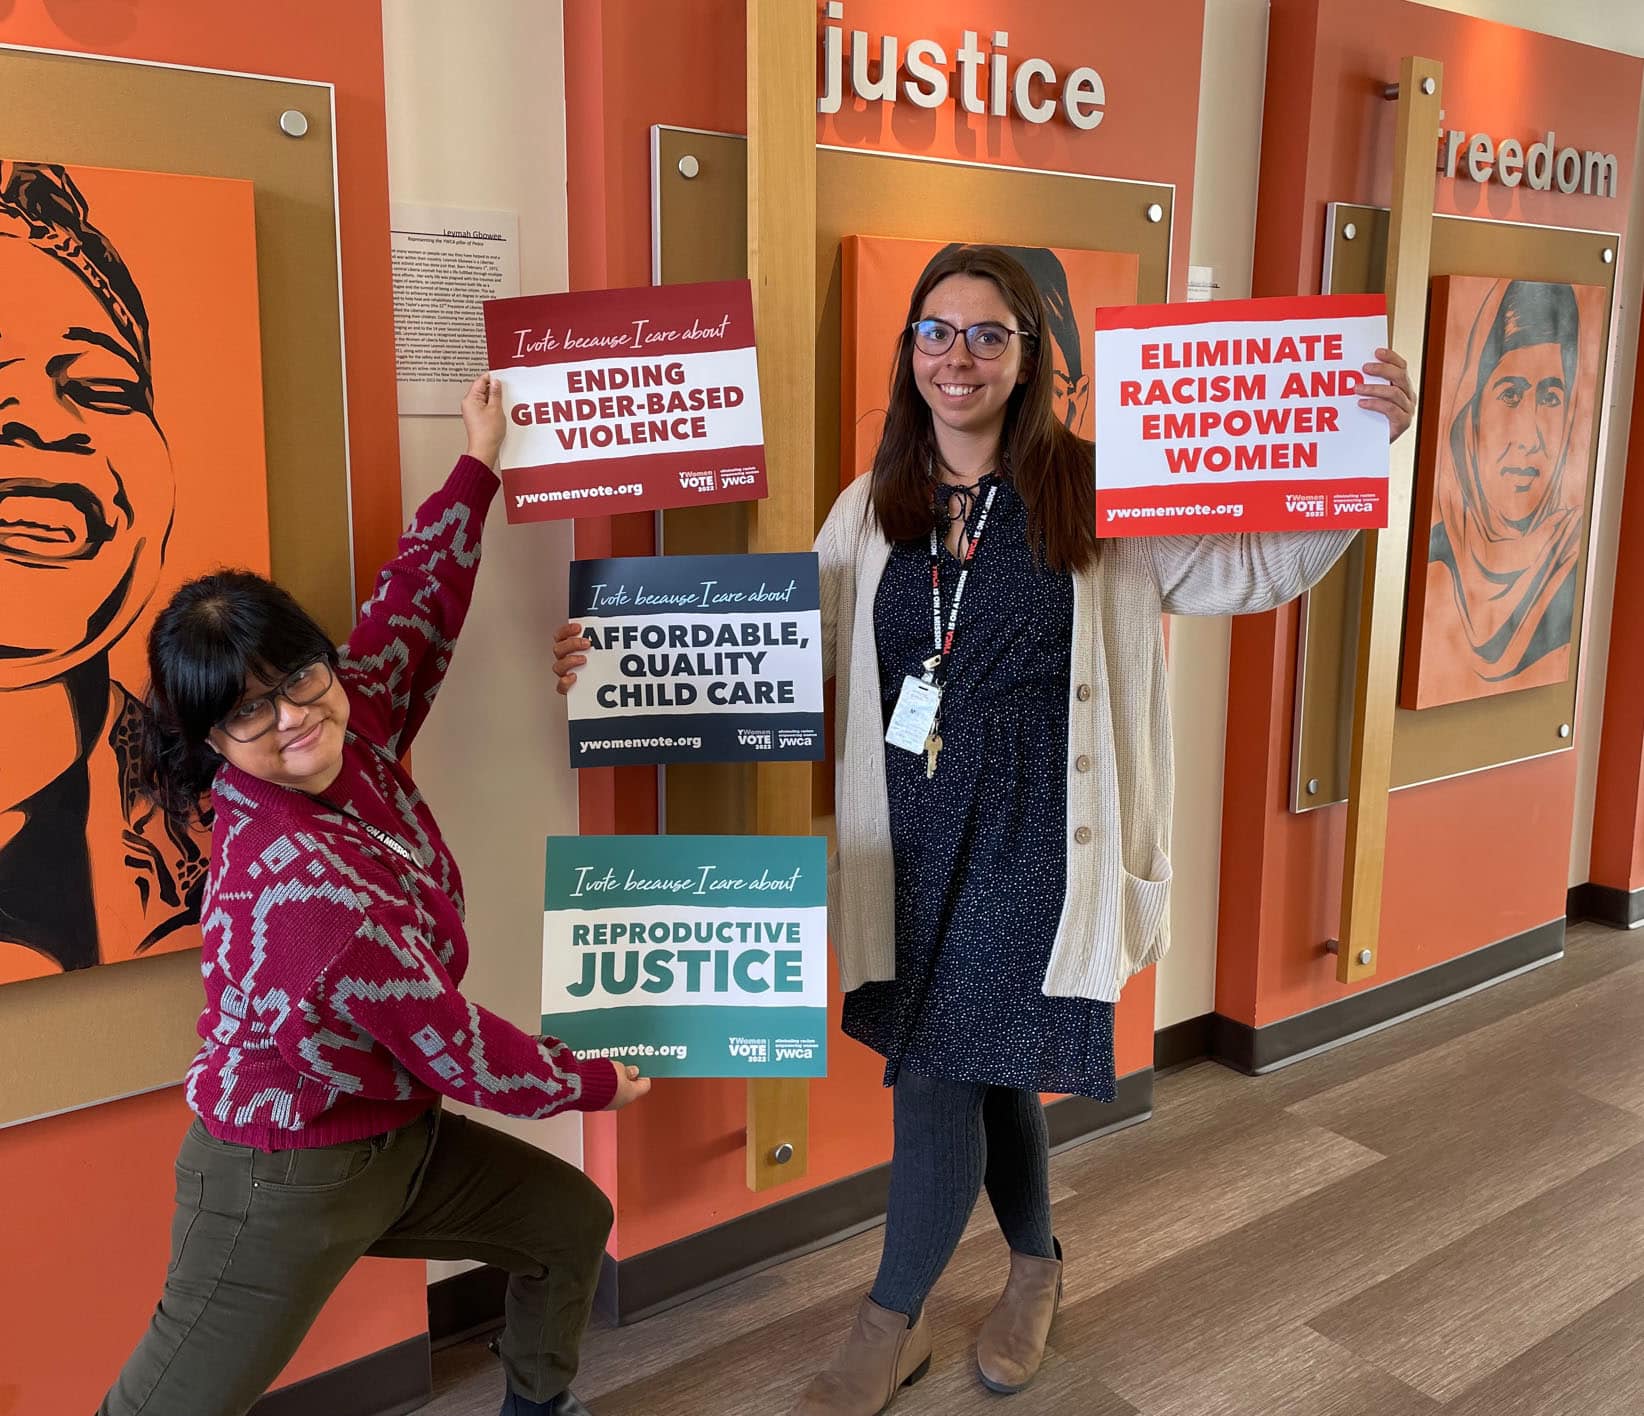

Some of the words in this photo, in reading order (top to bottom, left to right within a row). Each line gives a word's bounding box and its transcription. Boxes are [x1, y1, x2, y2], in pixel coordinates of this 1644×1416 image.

[817, 0, 1105, 130] justice
[443, 228, 471, 239] Leymah
[512, 328, 532, 359] I
[526, 328, 560, 352] vote
[564, 328, 632, 350] because
[630, 320, 649, 349] I
[645, 328, 682, 343] care
[682, 314, 731, 340] about
[1141, 334, 1344, 370] ELIMINATE
[566, 362, 686, 394] ENDING
[1120, 374, 1266, 406] RACISM
[1280, 370, 1364, 400] AND
[510, 386, 744, 426] GENDER-BASED
[555, 416, 707, 450] VIOLENCE
[1142, 406, 1340, 440] EMPOWER
[1164, 442, 1318, 474] WOMEN
[680, 476, 714, 488] VOTE
[722, 475, 755, 488] ywca
[515, 482, 644, 508] ywomenvote.org
[1286, 500, 1324, 512] VOTE
[1106, 503, 1244, 522] ywomenvote.org
[1334, 502, 1372, 516] ywca
[977, 520, 986, 530] ON
[587, 584, 607, 610] I
[600, 585, 632, 606] vote
[634, 586, 700, 606] because
[697, 581, 718, 608] I
[712, 590, 748, 603] care
[748, 580, 796, 603] about
[954, 570, 968, 602] MISSION
[933, 596, 940, 608] ON
[934, 608, 940, 616] A
[948, 622, 956, 630] IS
[950, 609, 958, 622] ON
[582, 622, 809, 650] AFFORDABLE,
[934, 616, 942, 650] MISSION
[943, 630, 954, 655] YWCA
[620, 651, 768, 678] QUALITY
[596, 684, 698, 708] CHILD
[706, 680, 795, 706] CARE
[580, 736, 702, 752] ywomenvote.org
[738, 735, 771, 744] VOTE
[780, 737, 812, 748] ywca
[376, 834, 385, 842] A
[569, 866, 594, 896] I
[586, 868, 622, 892] vote
[624, 869, 696, 892] because
[692, 866, 716, 894] I
[709, 876, 748, 890] care
[749, 867, 802, 892] about
[572, 922, 800, 946] REPRODUCTIVE
[566, 949, 804, 998] JUSTICE
[572, 1044, 688, 1060] omenvote.org
[728, 1044, 766, 1056] VOTE
[776, 1048, 813, 1061] ywca
